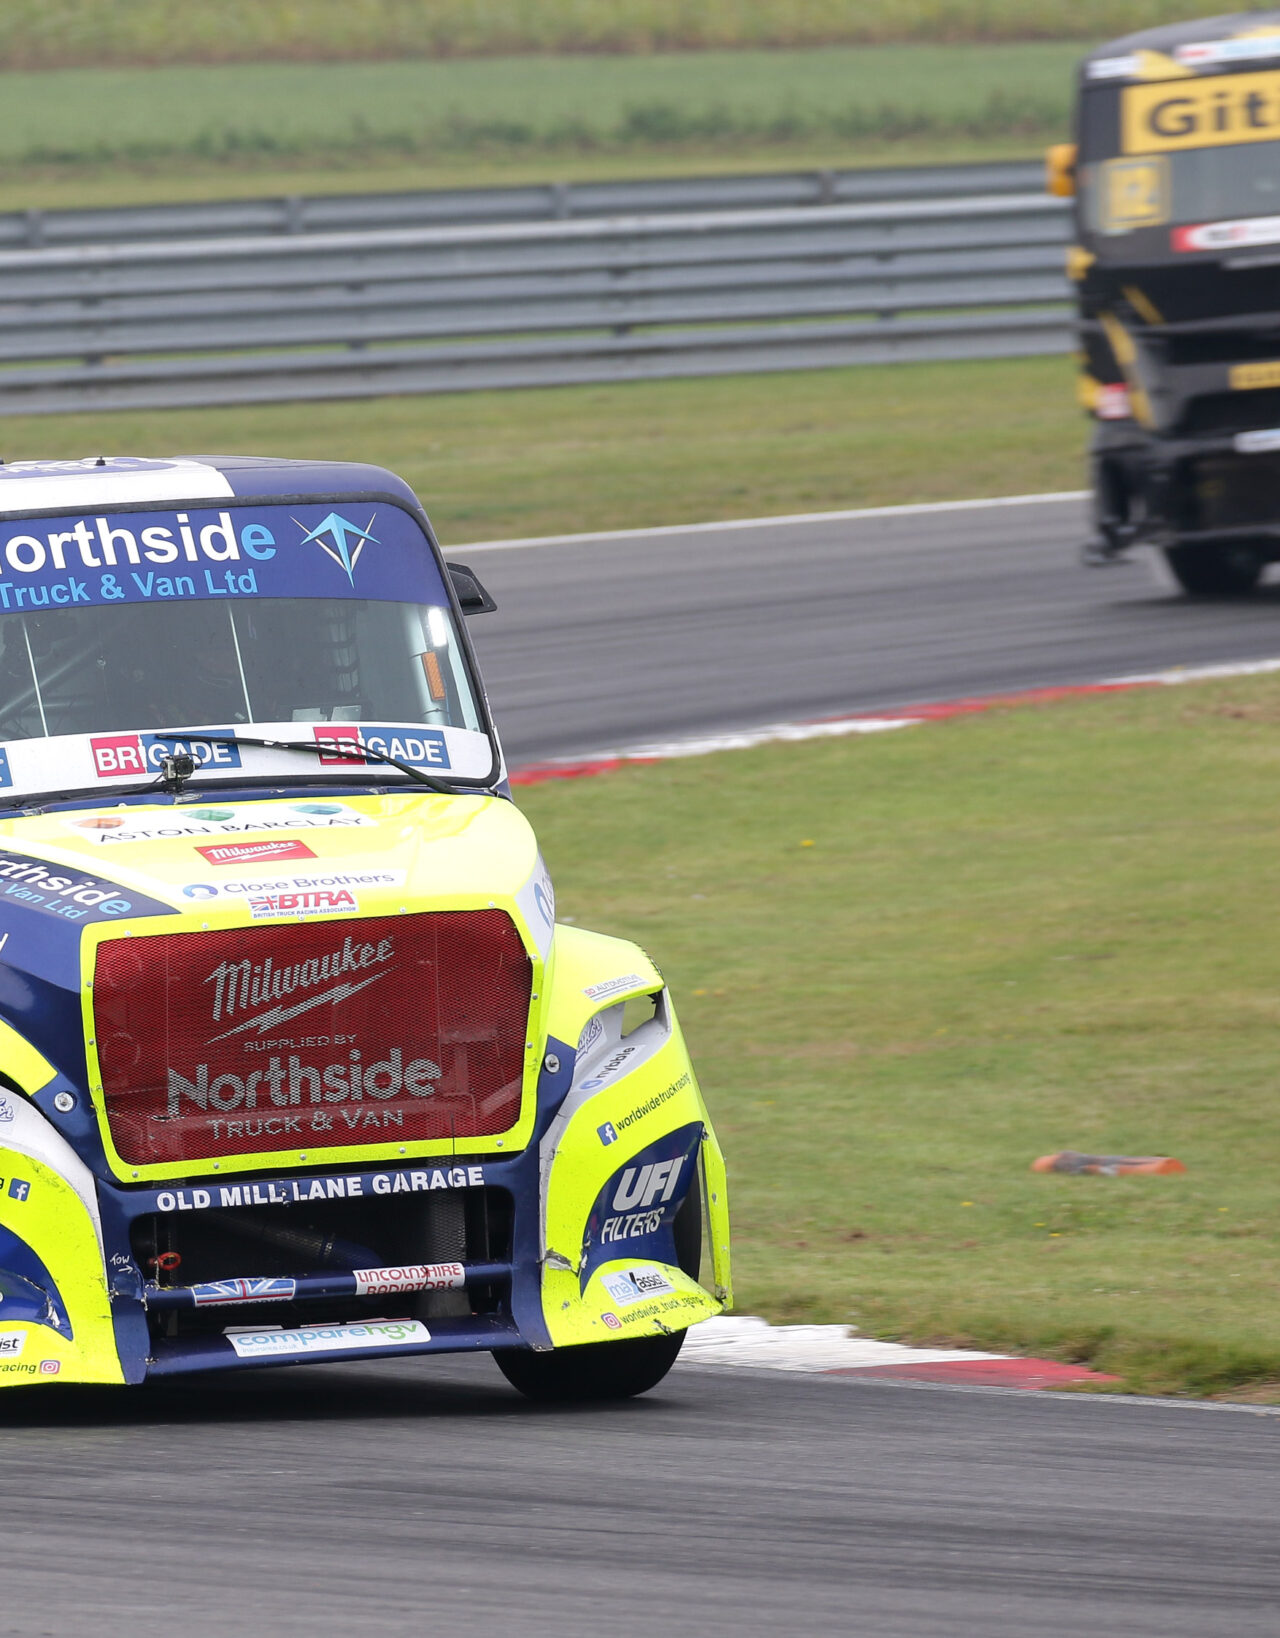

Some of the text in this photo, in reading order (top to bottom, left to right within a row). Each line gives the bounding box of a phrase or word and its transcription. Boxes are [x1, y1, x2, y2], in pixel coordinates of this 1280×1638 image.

[1145, 88, 1280, 138] Git
[100, 573, 125, 599] &
[131, 571, 196, 597] Van
[203, 568, 258, 595] Ltd
[100, 817, 363, 843] ASTON BARCLAY
[205, 841, 299, 859] Milwaukee
[223, 873, 396, 894] Close Brothers
[278, 889, 356, 910] BTRA
[4, 882, 47, 904] Van
[43, 898, 89, 920] Ltd
[253, 911, 276, 919] BRITISH
[276, 909, 296, 917] TRUCK
[319, 906, 357, 914] ASSOCIATION
[202, 935, 396, 1022] Milwaukee
[243, 1033, 357, 1052] SUPPLIED BY
[596, 1046, 636, 1079] nybble
[167, 1047, 442, 1119] Northside
[616, 1072, 691, 1131] worldwidetruckracing
[206, 1108, 405, 1140] TRUCK & VAN
[156, 1166, 485, 1212] OLD MILL LANE GARAGE
[612, 1155, 685, 1212] UFI
[601, 1207, 666, 1245] FILTERS
[356, 1264, 462, 1284] LINCOLNSHIRE
[236, 1322, 418, 1346] comparehgv
